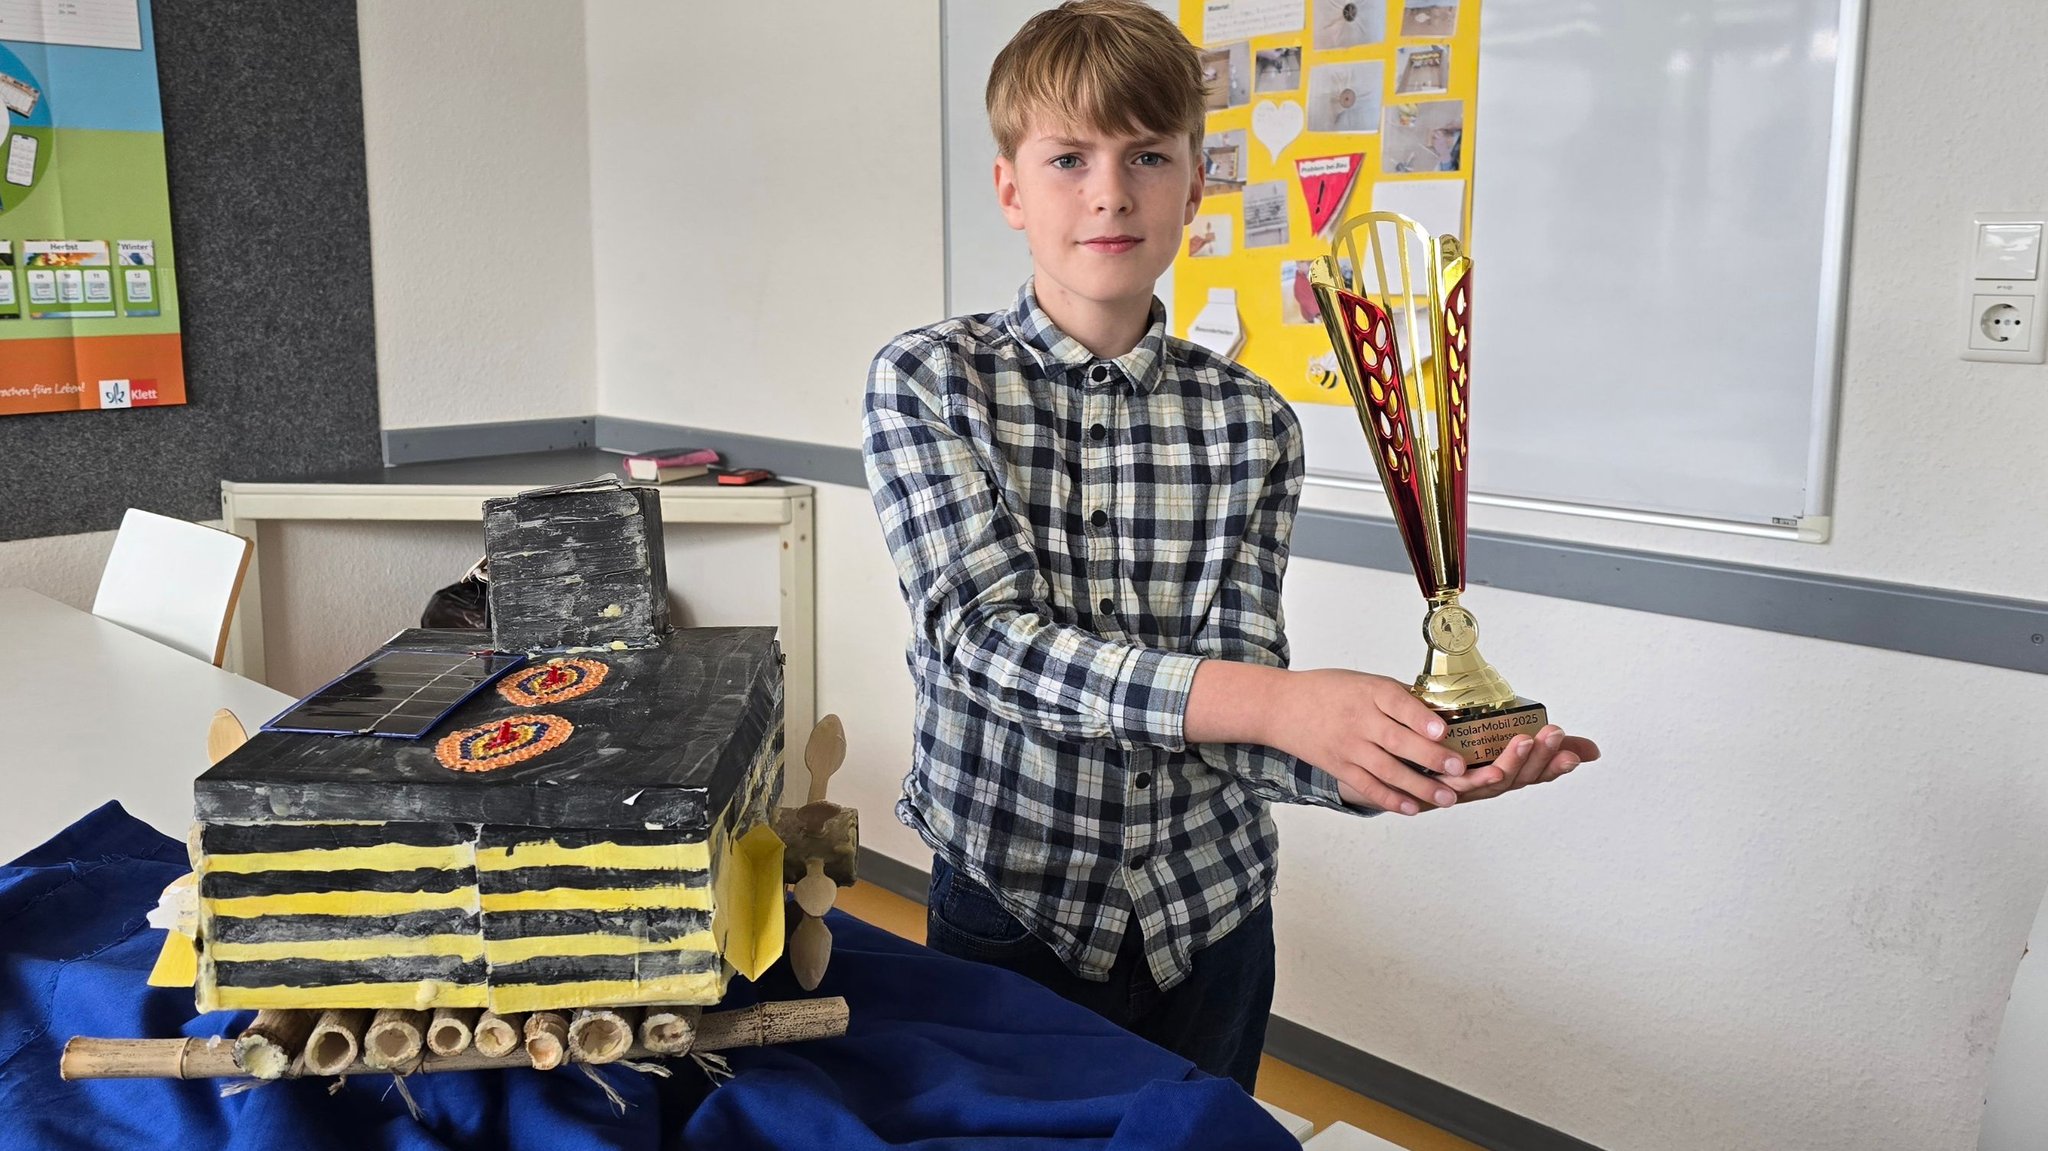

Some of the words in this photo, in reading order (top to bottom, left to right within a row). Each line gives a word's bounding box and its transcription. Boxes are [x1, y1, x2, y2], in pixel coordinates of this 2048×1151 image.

[50, 242, 79, 251] Herbst
[121, 243, 149, 251] Winter
[55, 382, 86, 395] Leben!
[131, 389, 158, 401] Klett
[1445, 729, 1456, 739] M
[1456, 719, 1511, 737] SolarMobil
[1512, 714, 1538, 727] 2025
[1474, 750, 1484, 760] 1.
[1485, 746, 1506, 758] Plat
